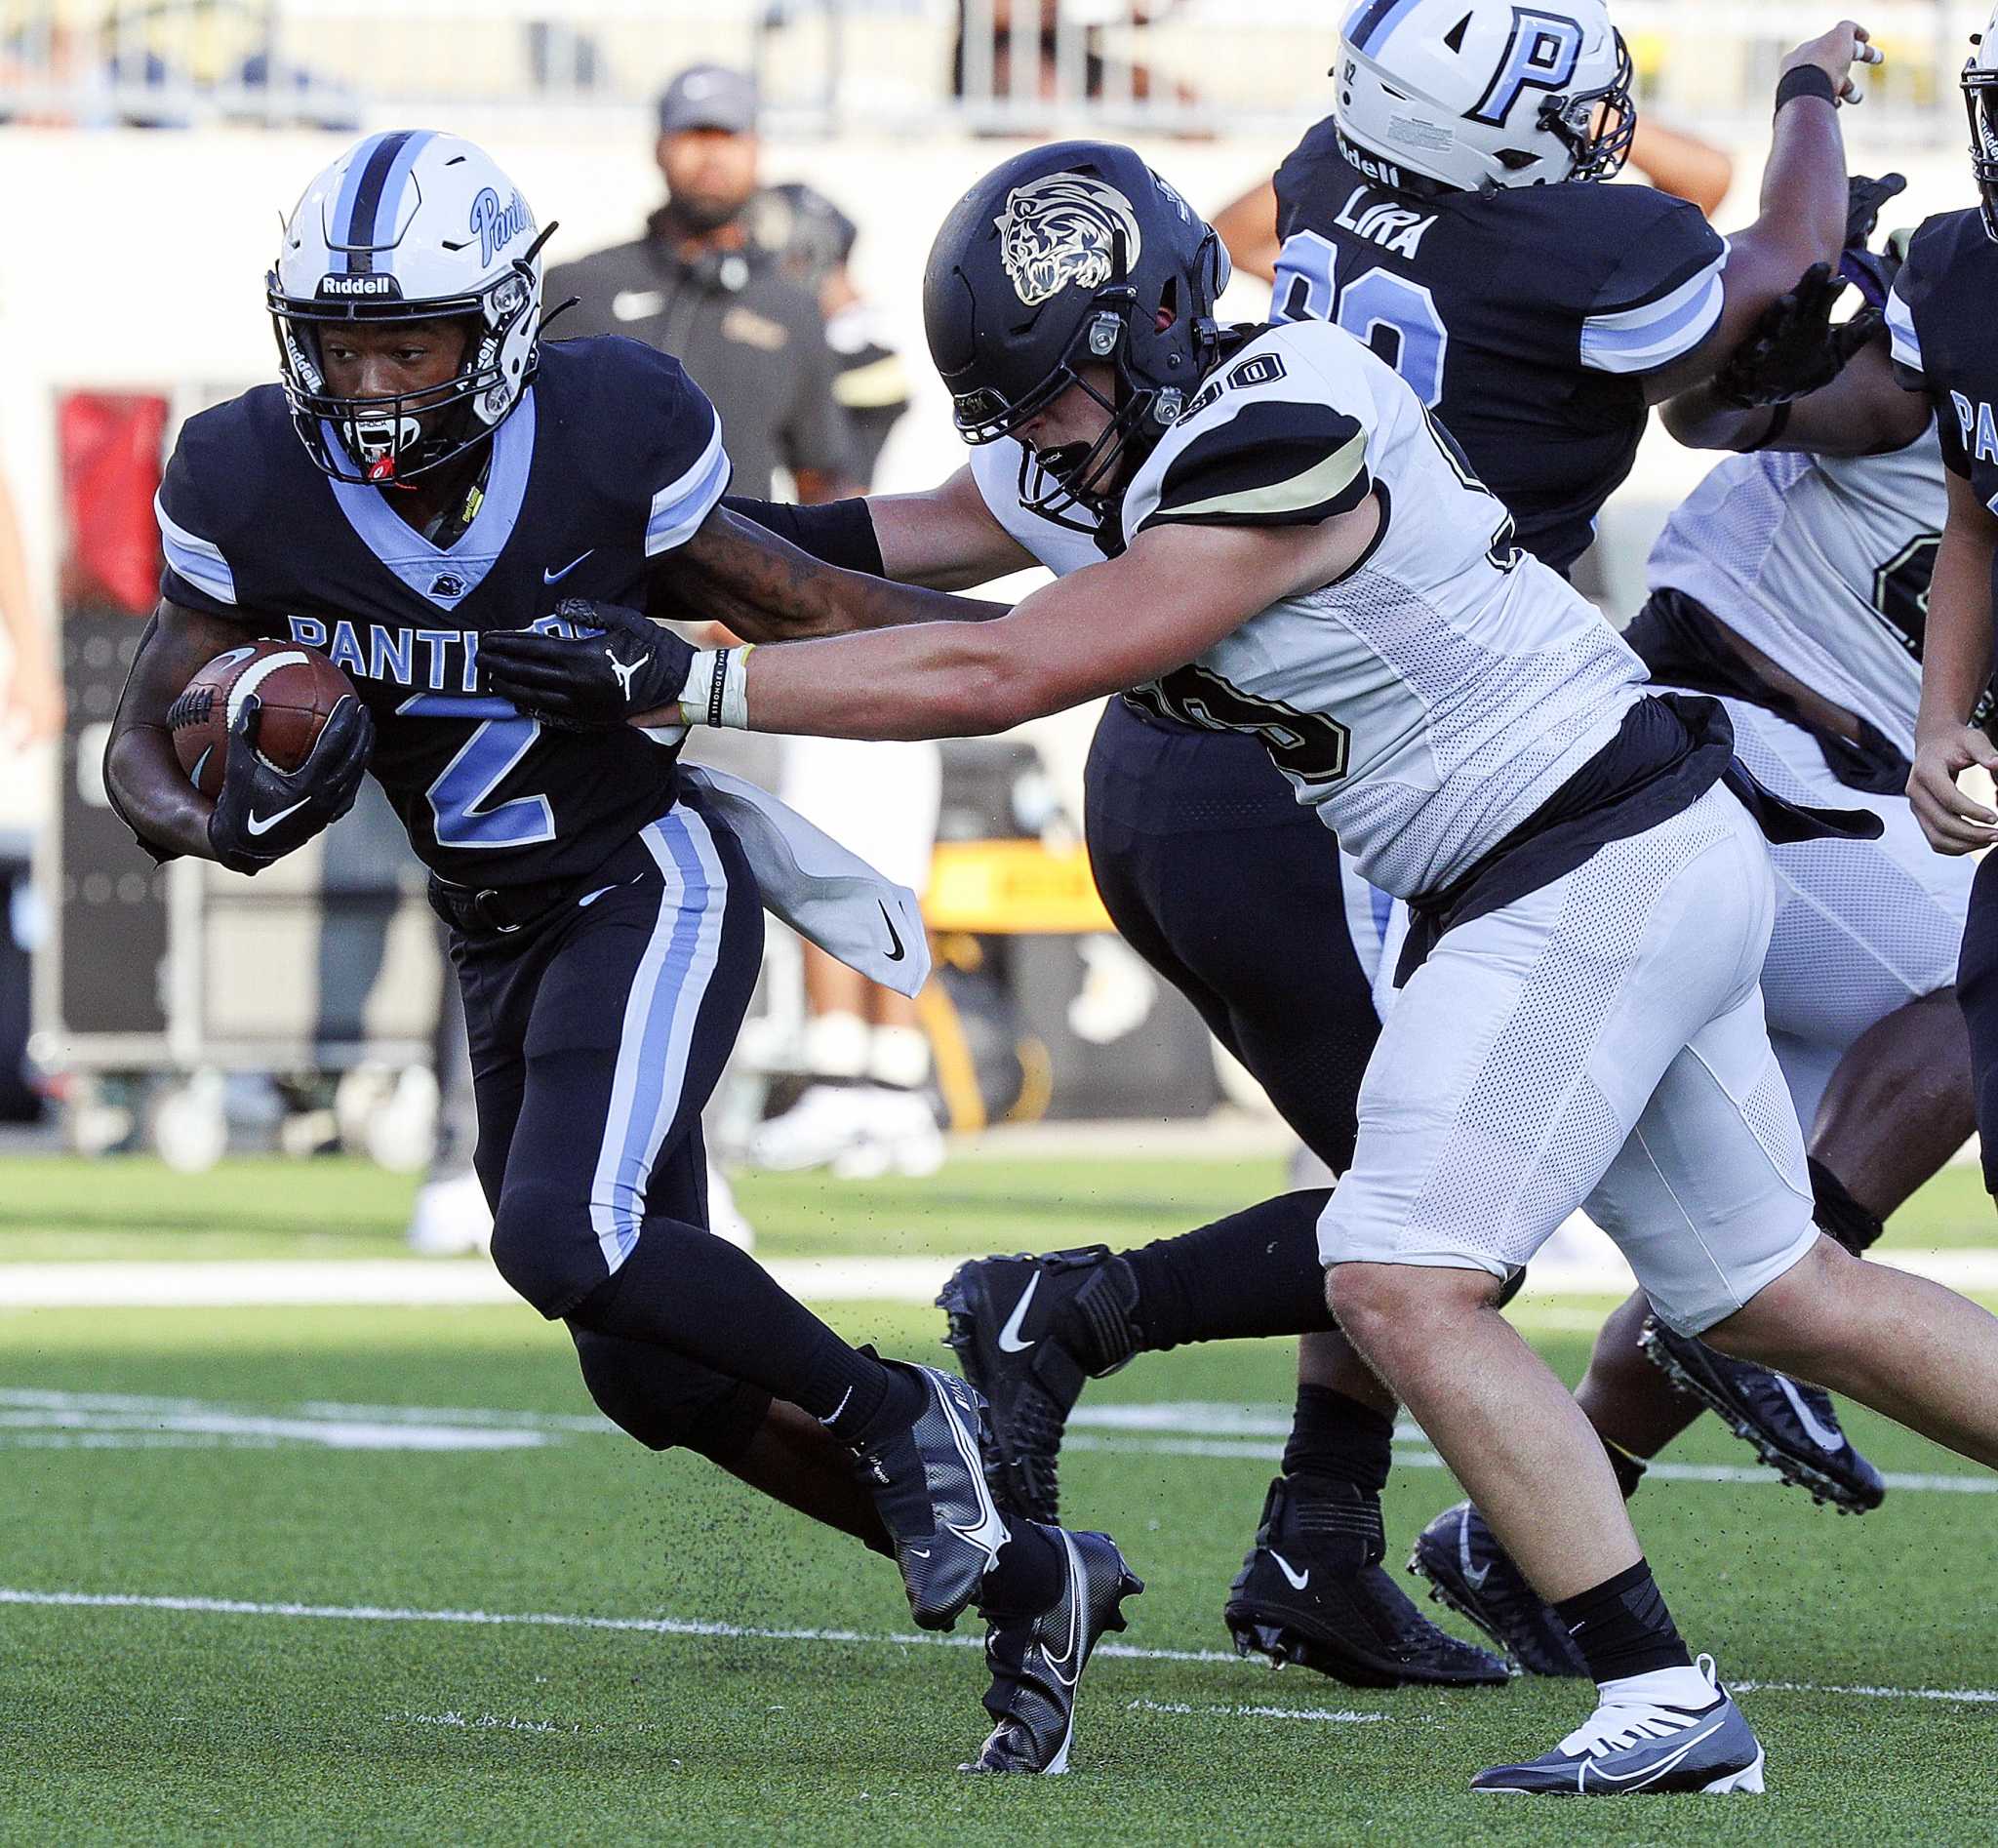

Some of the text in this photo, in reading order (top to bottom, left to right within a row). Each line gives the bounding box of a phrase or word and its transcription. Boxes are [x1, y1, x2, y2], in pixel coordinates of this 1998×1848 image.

[1460, 6, 1584, 129] P
[1333, 185, 1439, 260] LIRA
[323, 277, 390, 294] Riddell
[395, 691, 557, 849] 2
